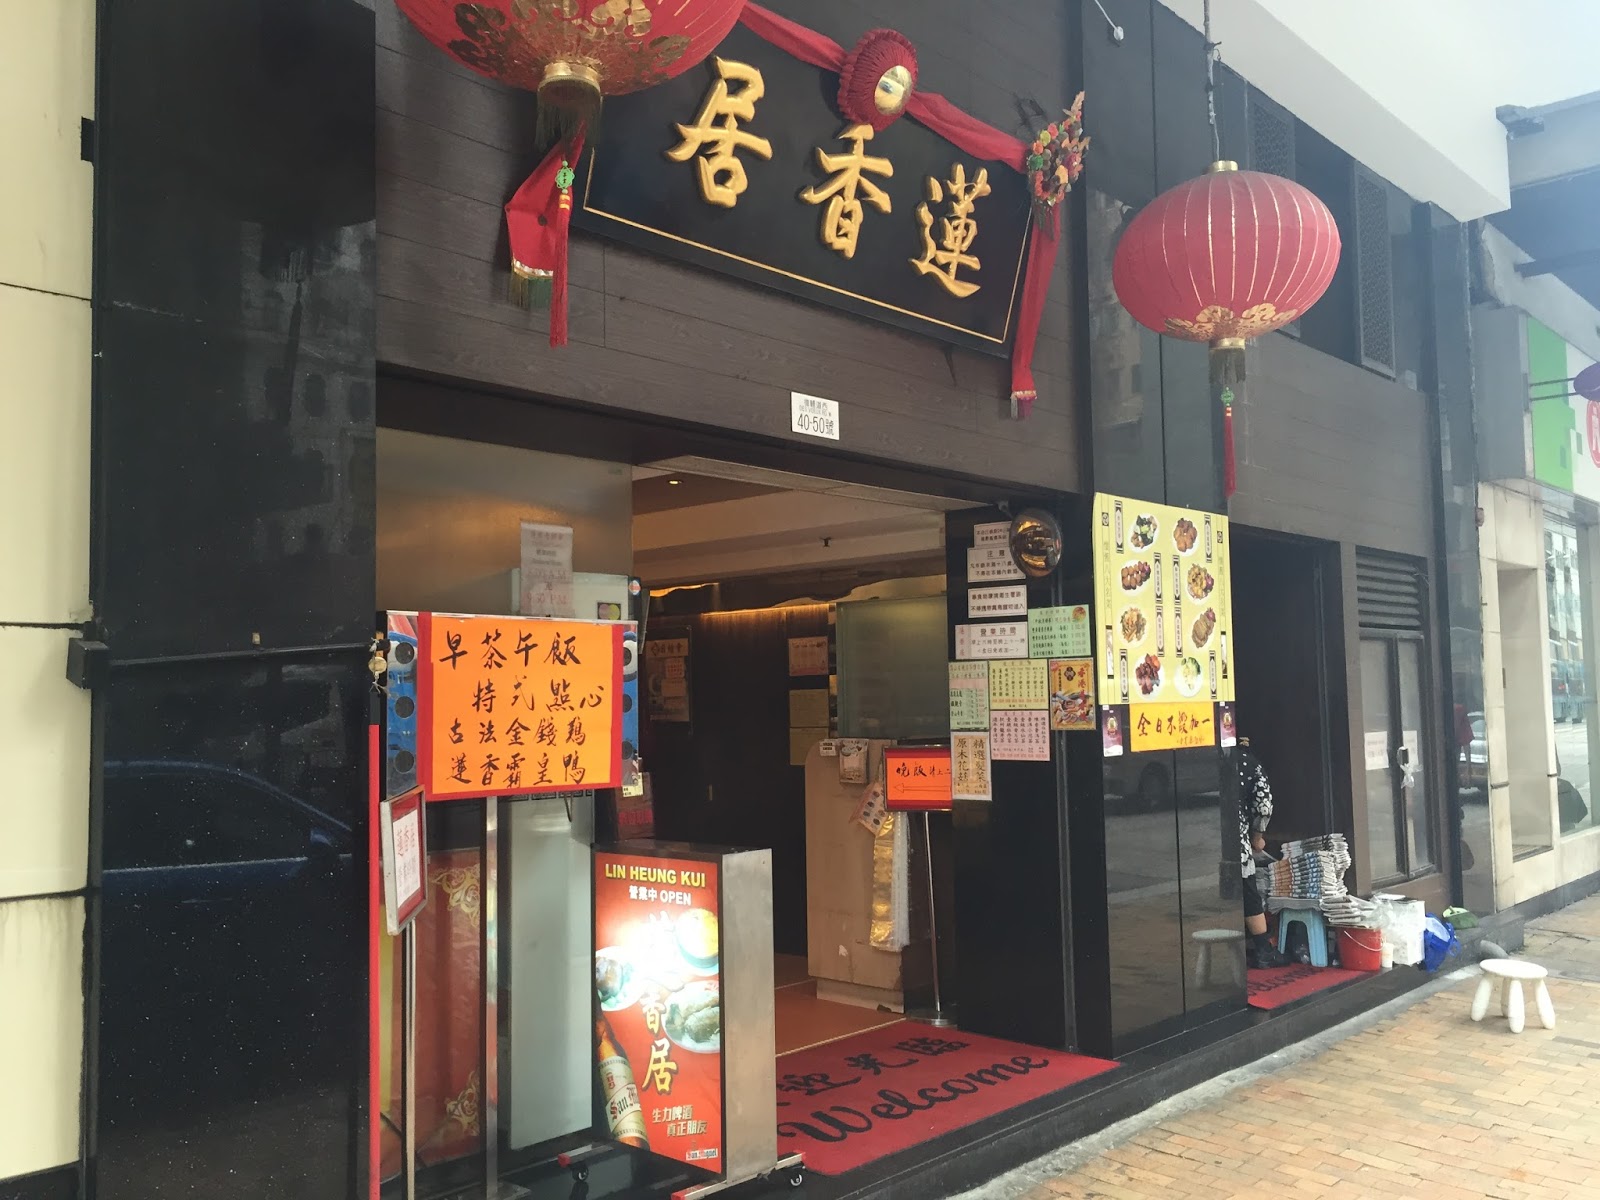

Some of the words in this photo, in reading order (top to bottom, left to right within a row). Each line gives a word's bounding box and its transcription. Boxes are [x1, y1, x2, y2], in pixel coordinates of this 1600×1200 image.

[439, 629, 581, 670] 早茶午飯
[472, 675, 604, 714] 特式點心
[605, 863, 626, 880] LIN
[630, 866, 677, 884] HEUNG
[681, 870, 706, 888] KUI
[628, 885, 658, 901] 營業中
[660, 890, 691, 905] OPEN
[778, 1055, 1049, 1142] Welcome
[652, 1104, 693, 1123] 生力啤酒
[667, 1120, 708, 1137] 真正朋友
